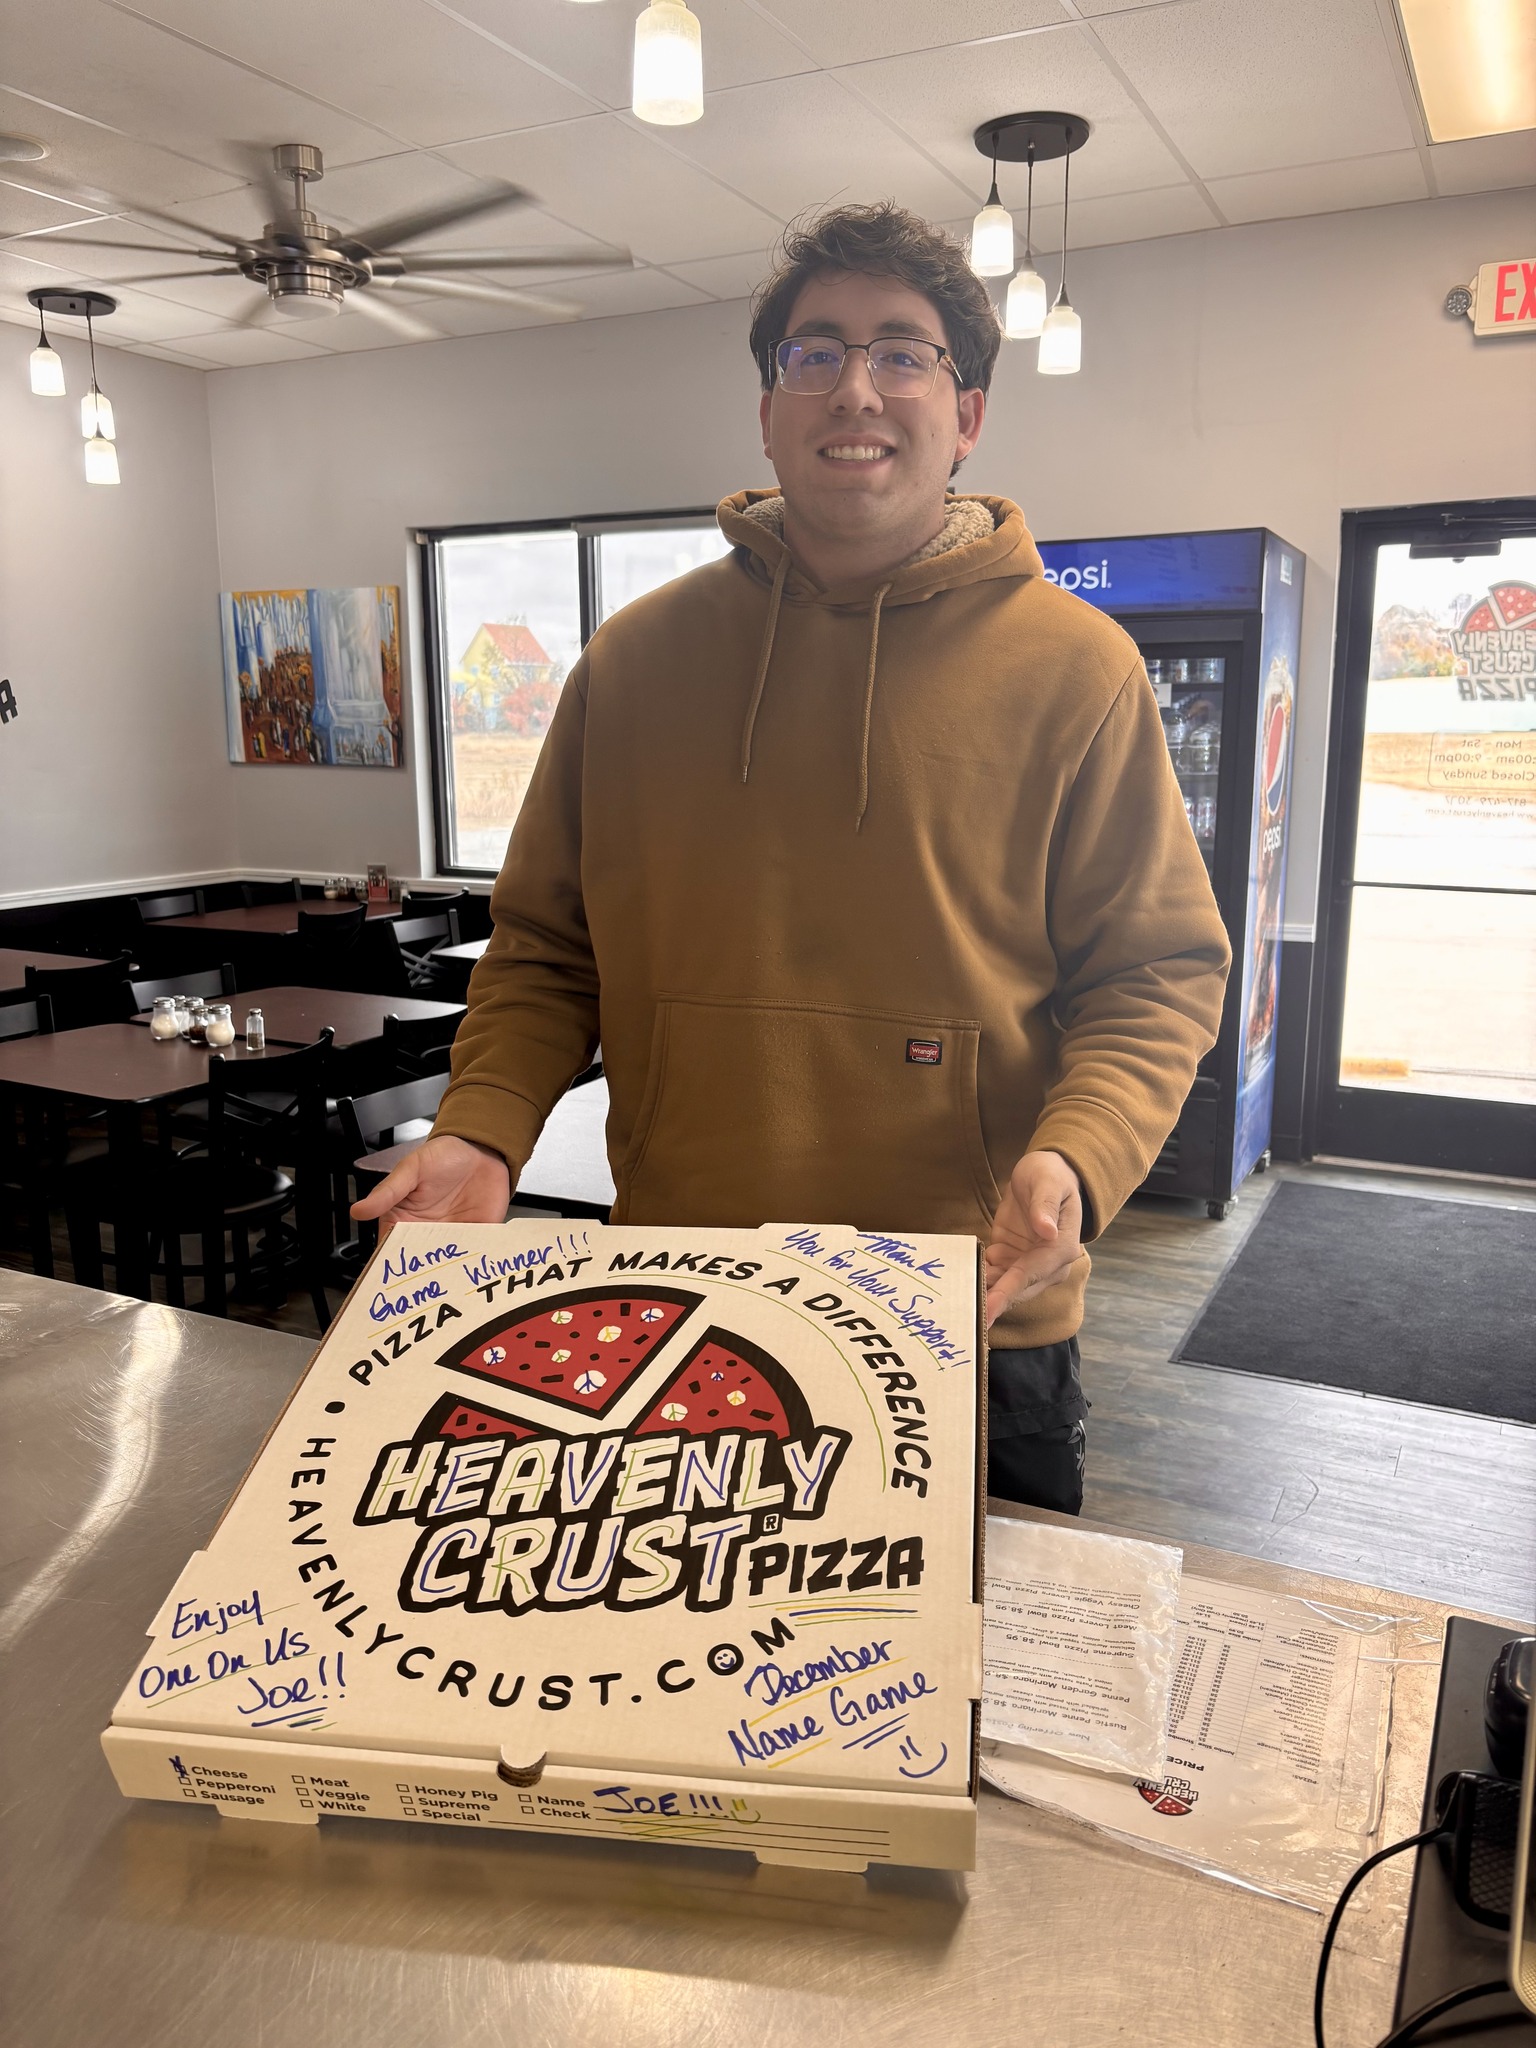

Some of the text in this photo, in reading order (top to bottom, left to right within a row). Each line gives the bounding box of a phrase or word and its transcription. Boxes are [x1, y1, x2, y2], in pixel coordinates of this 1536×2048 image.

[1495, 262, 1536, 322] EX
[911, 1046, 938, 1058] Wrangler
[382, 1243, 469, 1286] Name
[368, 1279, 448, 1323] Game
[348, 1250, 928, 1499] PIZZA THAT MAKES A DIFFERENCE
[355, 1424, 851, 1524] HEAVENLY
[398, 1513, 753, 1617] CRUST
[748, 1536, 925, 1597] PIZZA
[991, 1582, 1011, 1591] Bowl
[1015, 1586, 1037, 1594] Pizza
[1041, 1590, 1070, 1600] Lovers
[1074, 1594, 1104, 1606] Veggie
[994, 1603, 1023, 1613] $8.95
[1107, 1600, 1140, 1610] Cheesy
[170, 1590, 264, 1640] Enjoy
[1027, 1609, 1047, 1618] Bowl
[1050, 1613, 1075, 1622] Pizza
[1078, 1618, 1109, 1629] Lovers
[1005, 1633, 1134, 1658] Supreme Pizza Bowl $8.95
[139, 1662, 200, 1699] One
[744, 1640, 893, 1707] December
[1012, 1675, 1057, 1689] Marinara
[1060, 1684, 1097, 1697] Garden
[1101, 1692, 1130, 1703] Penne
[1011, 1703, 1057, 1717] Marinara
[727, 1671, 938, 1767] Name Game
[1061, 1713, 1090, 1723] Penne
[1094, 1719, 1127, 1730] Rustic
[1166, 1755, 1205, 1771] PRICE
[191, 1766, 249, 1781] Cheese
[196, 1778, 277, 1796] Pepperoni
[309, 1776, 350, 1790] Meat
[200, 1789, 266, 1806] Sausage
[313, 1788, 371, 1804] Veggie
[414, 1784, 499, 1804] Honey Pig
[537, 1794, 586, 1809] Name
[318, 1799, 367, 1814] White
[418, 1796, 492, 1814] Supreme
[421, 1807, 481, 1823] Special
[540, 1805, 591, 1821] Check
